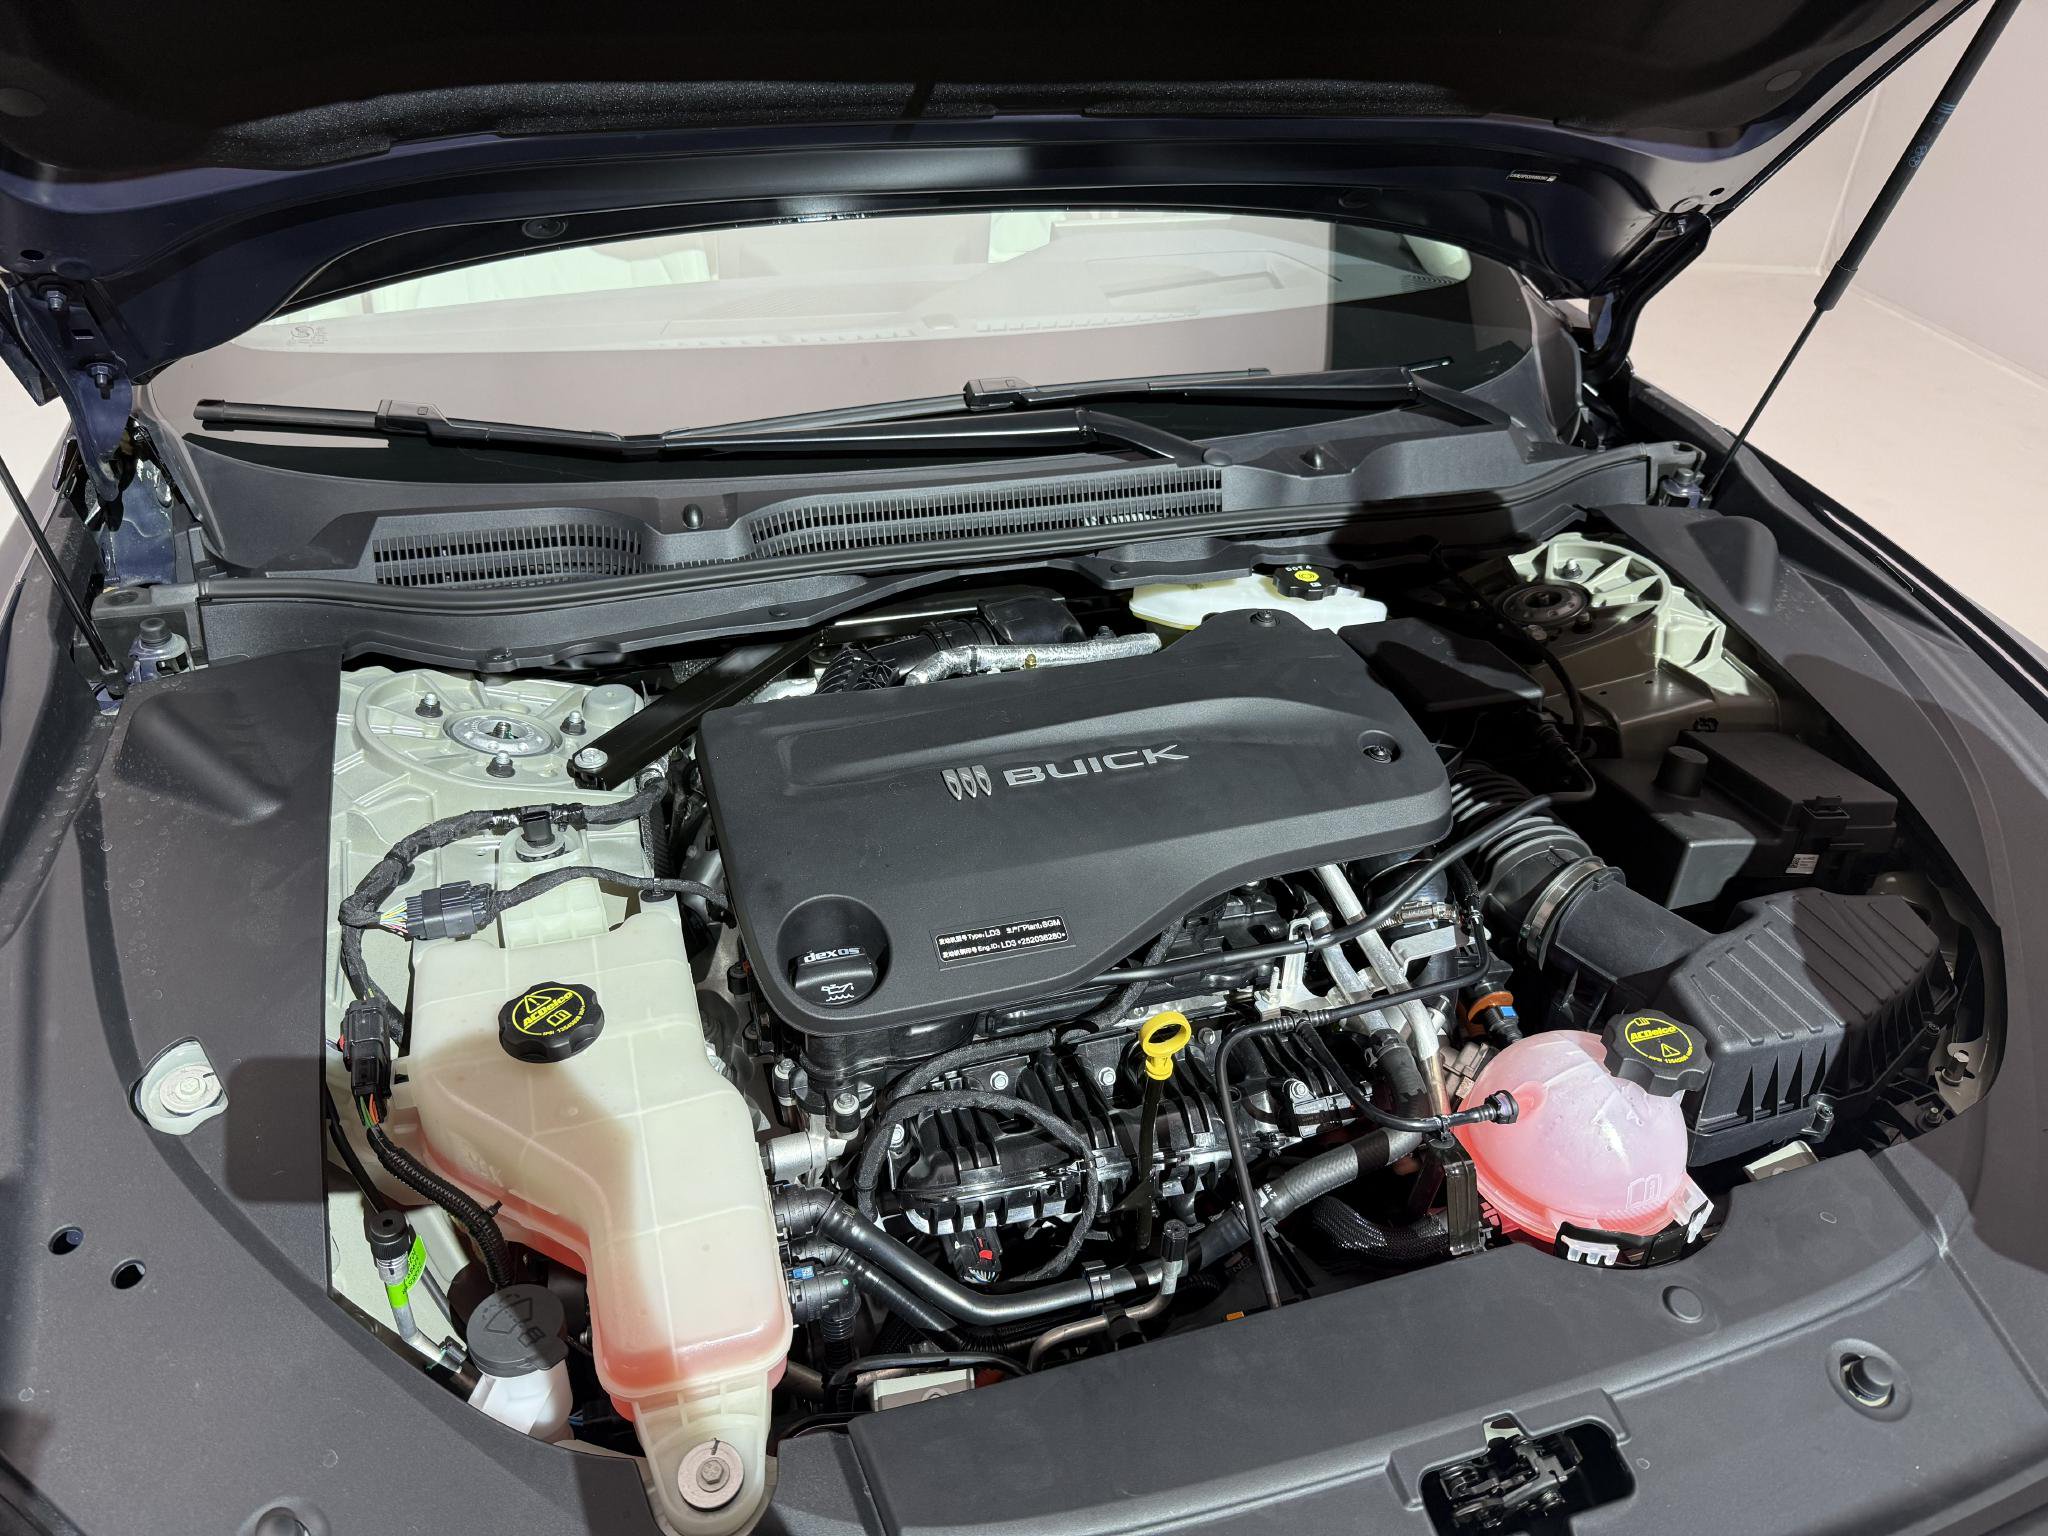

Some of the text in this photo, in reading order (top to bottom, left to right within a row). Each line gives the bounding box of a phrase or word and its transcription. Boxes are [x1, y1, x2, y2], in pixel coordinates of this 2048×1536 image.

[1003, 744, 1190, 786] BUICK
[803, 947, 860, 963] dexos
[523, 991, 574, 1028] ACDelco
[1630, 1025, 1677, 1041] ACDelco
